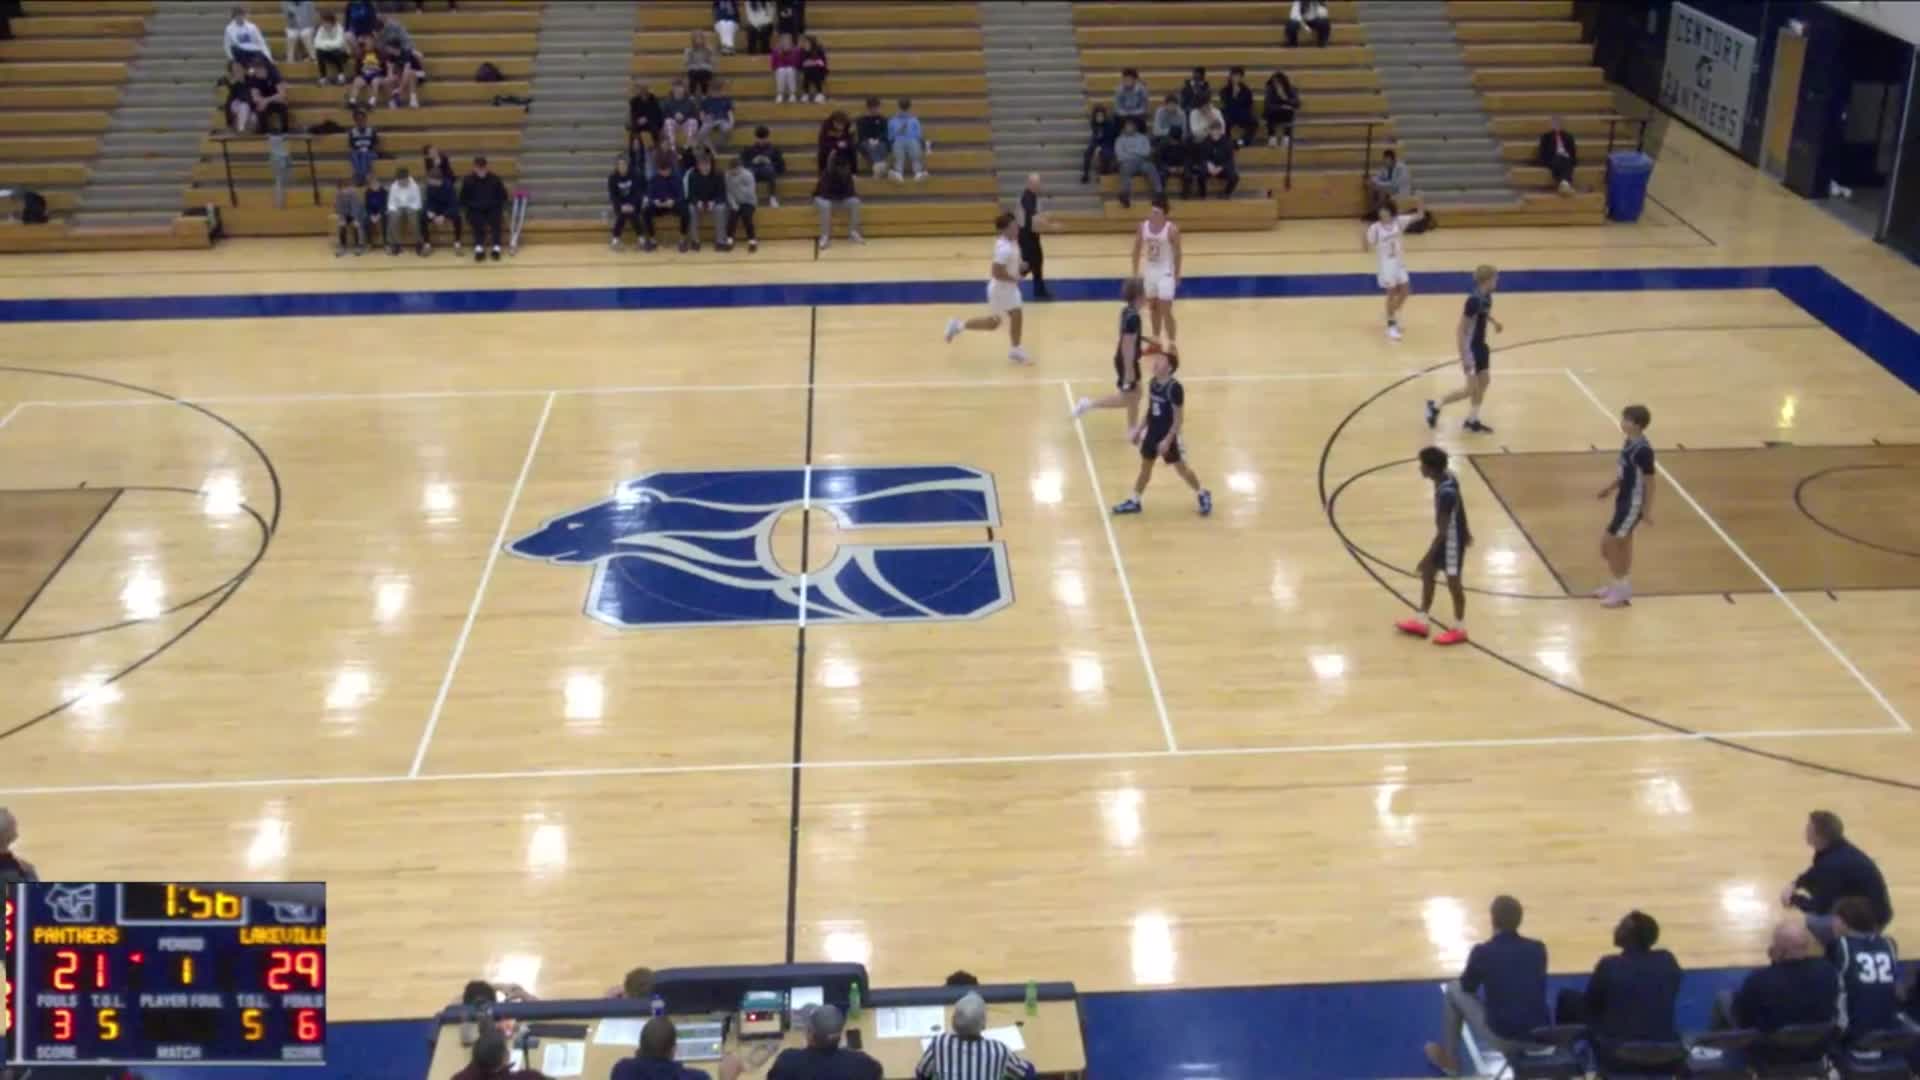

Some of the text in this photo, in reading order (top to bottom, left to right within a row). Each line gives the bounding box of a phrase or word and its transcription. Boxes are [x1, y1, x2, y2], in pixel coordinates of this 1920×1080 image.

[1677, 13, 1744, 72] CENTURY
[1663, 70, 1738, 138] PANTHERS
[1855, 952, 1895, 984] 32
